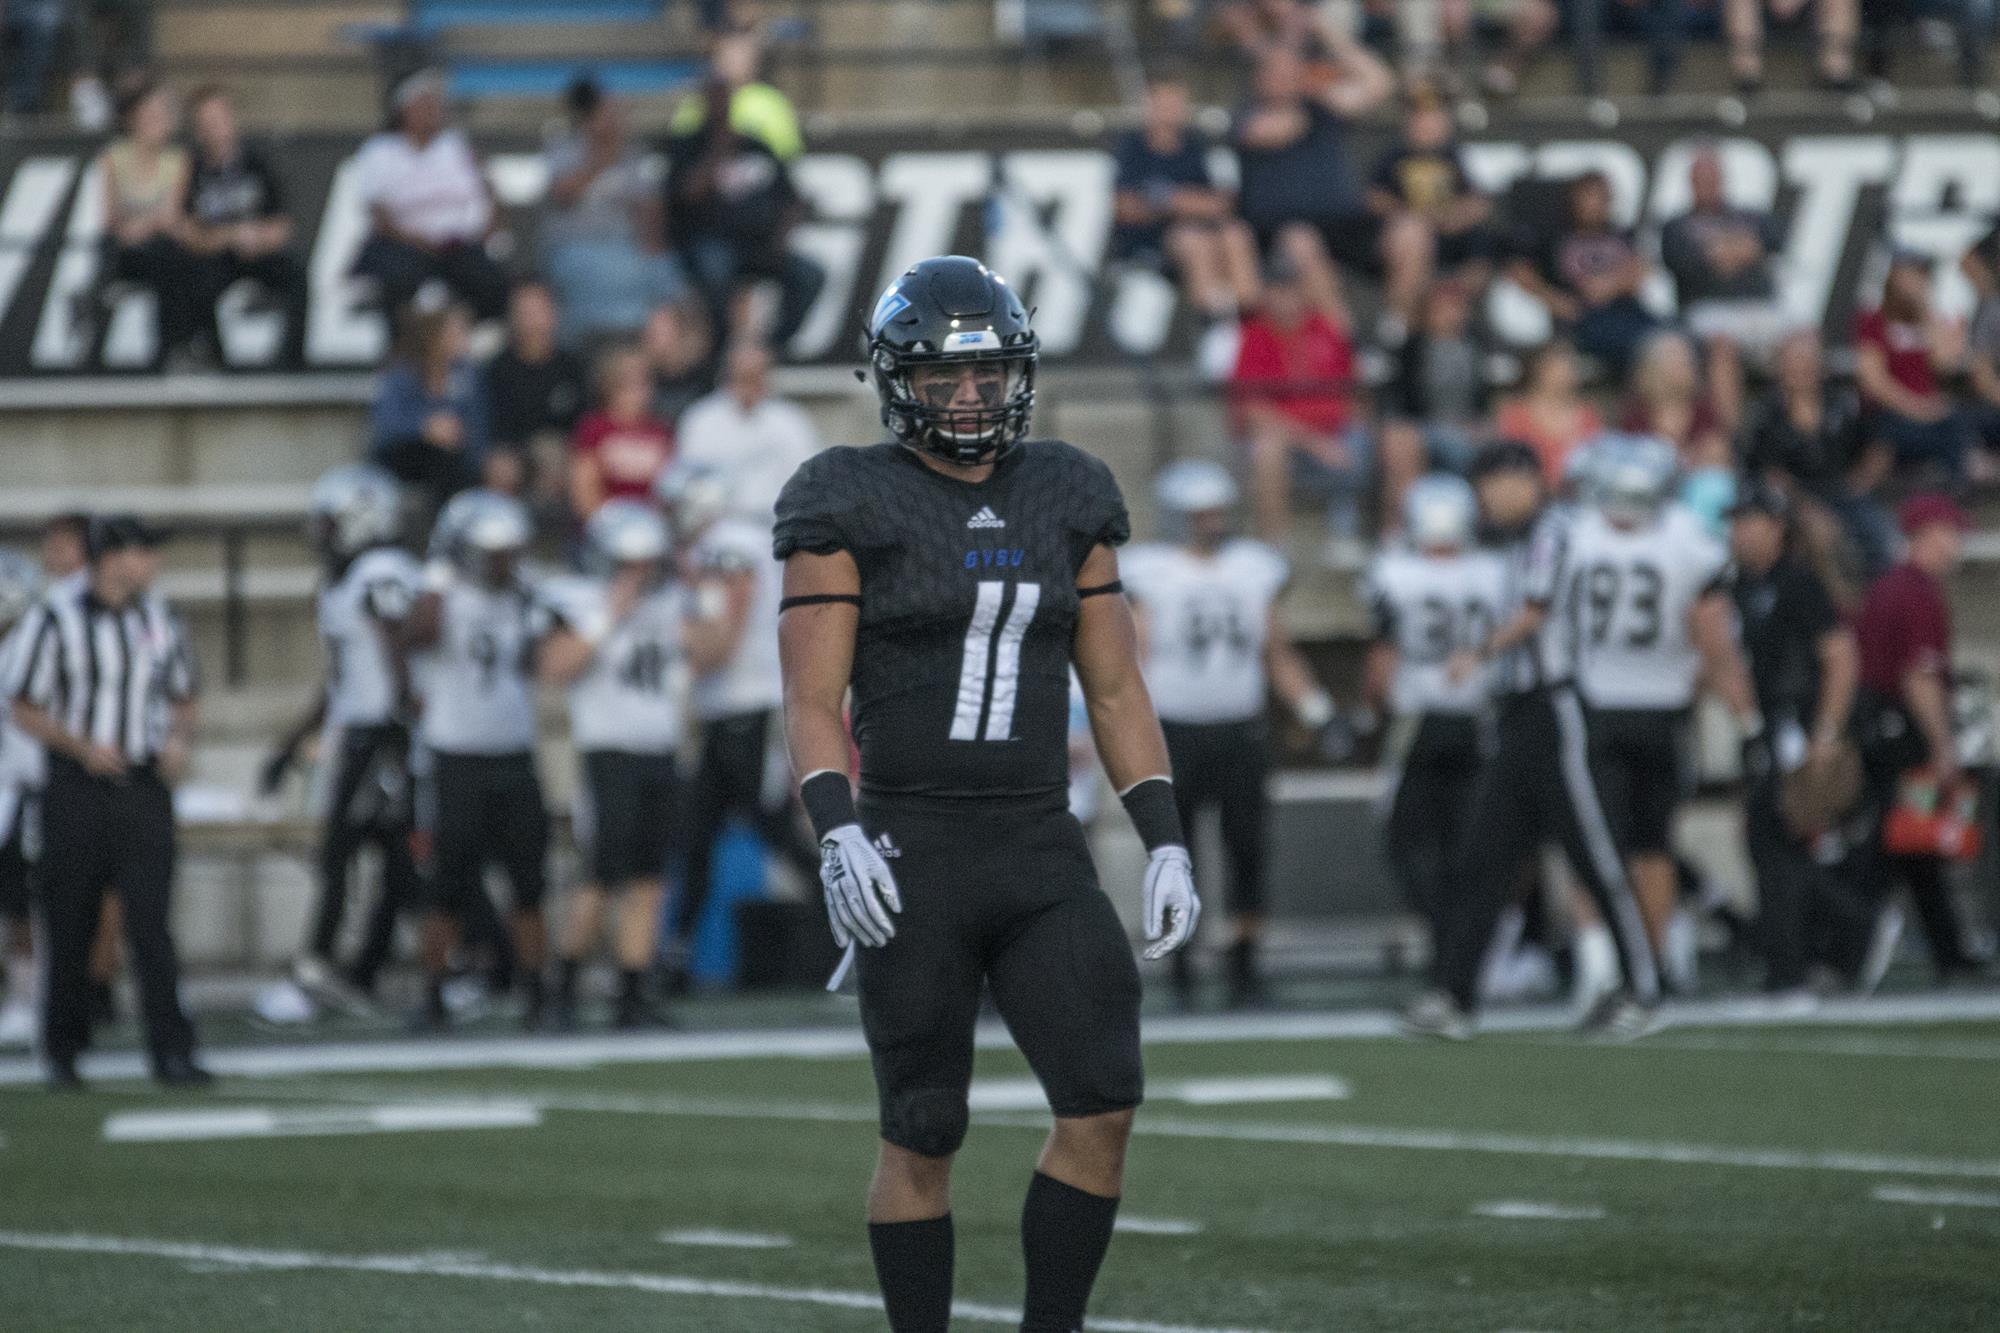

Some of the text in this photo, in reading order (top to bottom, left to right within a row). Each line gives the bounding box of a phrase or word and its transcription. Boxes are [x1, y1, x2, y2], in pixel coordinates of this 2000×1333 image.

[967, 518, 1006, 529] adidas
[1588, 562, 1663, 649] 93
[949, 581, 1040, 741] 11
